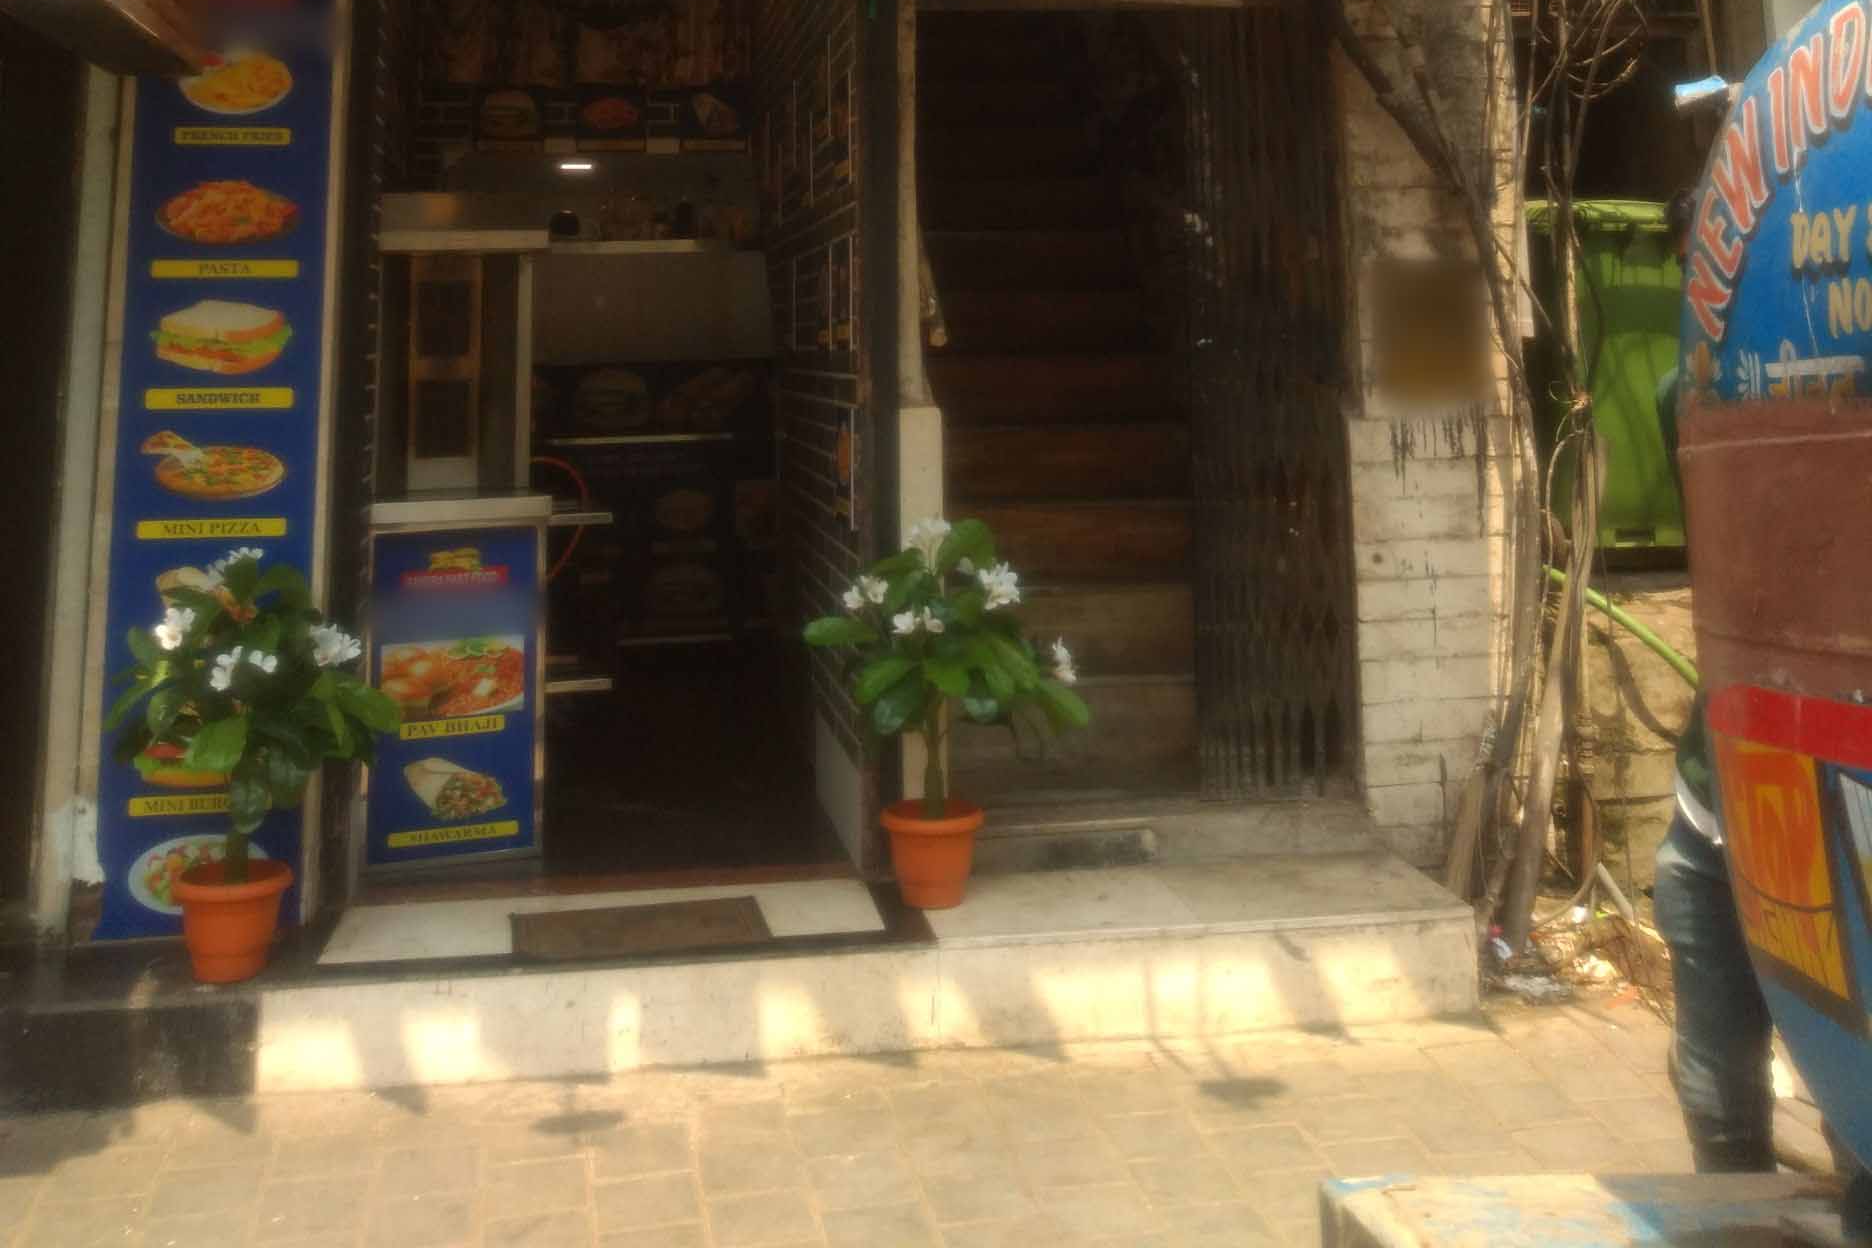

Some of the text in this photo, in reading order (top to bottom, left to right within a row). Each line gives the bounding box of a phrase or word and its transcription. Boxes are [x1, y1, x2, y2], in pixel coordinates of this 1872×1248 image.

[1687, 95, 1770, 343] NEW
[1791, 205, 1858, 270] DAY
[199, 262, 252, 275] PASTA
[175, 392, 261, 405] SANDWICH
[163, 521, 262, 536] MINI PIZZA
[406, 717, 499, 738] PAV BHAJI
[143, 798, 184, 814] MINI
